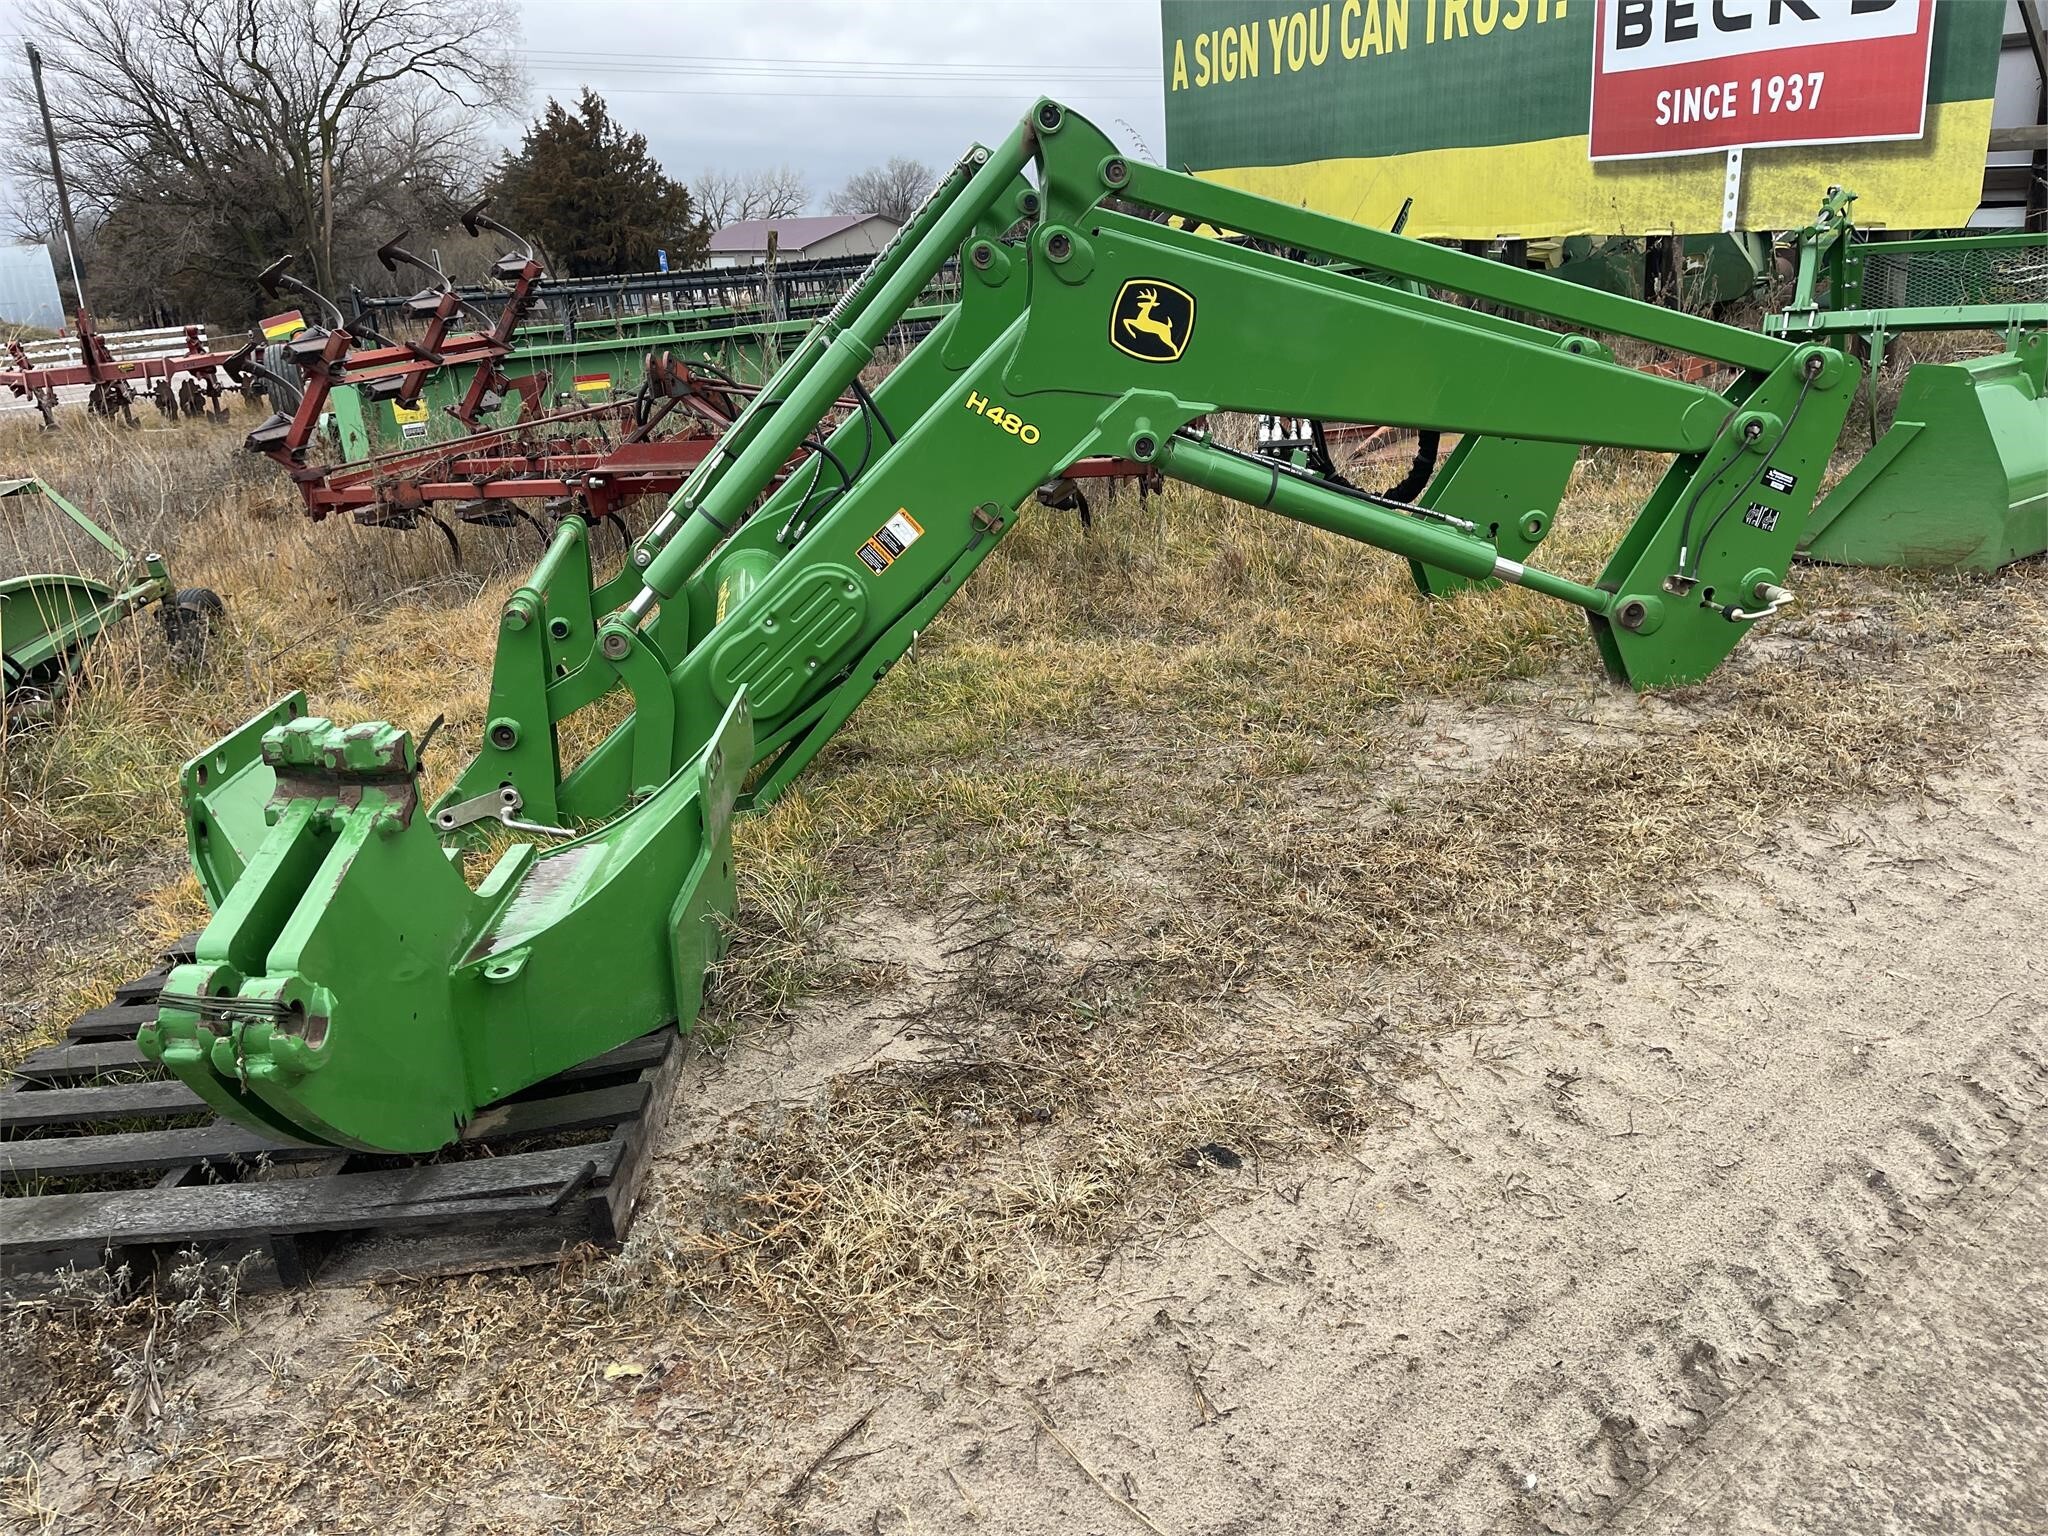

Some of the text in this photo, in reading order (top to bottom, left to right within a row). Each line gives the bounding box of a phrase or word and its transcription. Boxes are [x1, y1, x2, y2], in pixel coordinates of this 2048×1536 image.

[1172, 40, 1189, 91] A
[1195, 22, 1259, 87] SIGN
[1268, 5, 1329, 75] YOU
[1340, 0, 1408, 60] CAN
[1655, 71, 1825, 126] SINCE 1937
[965, 390, 1041, 445] H480
